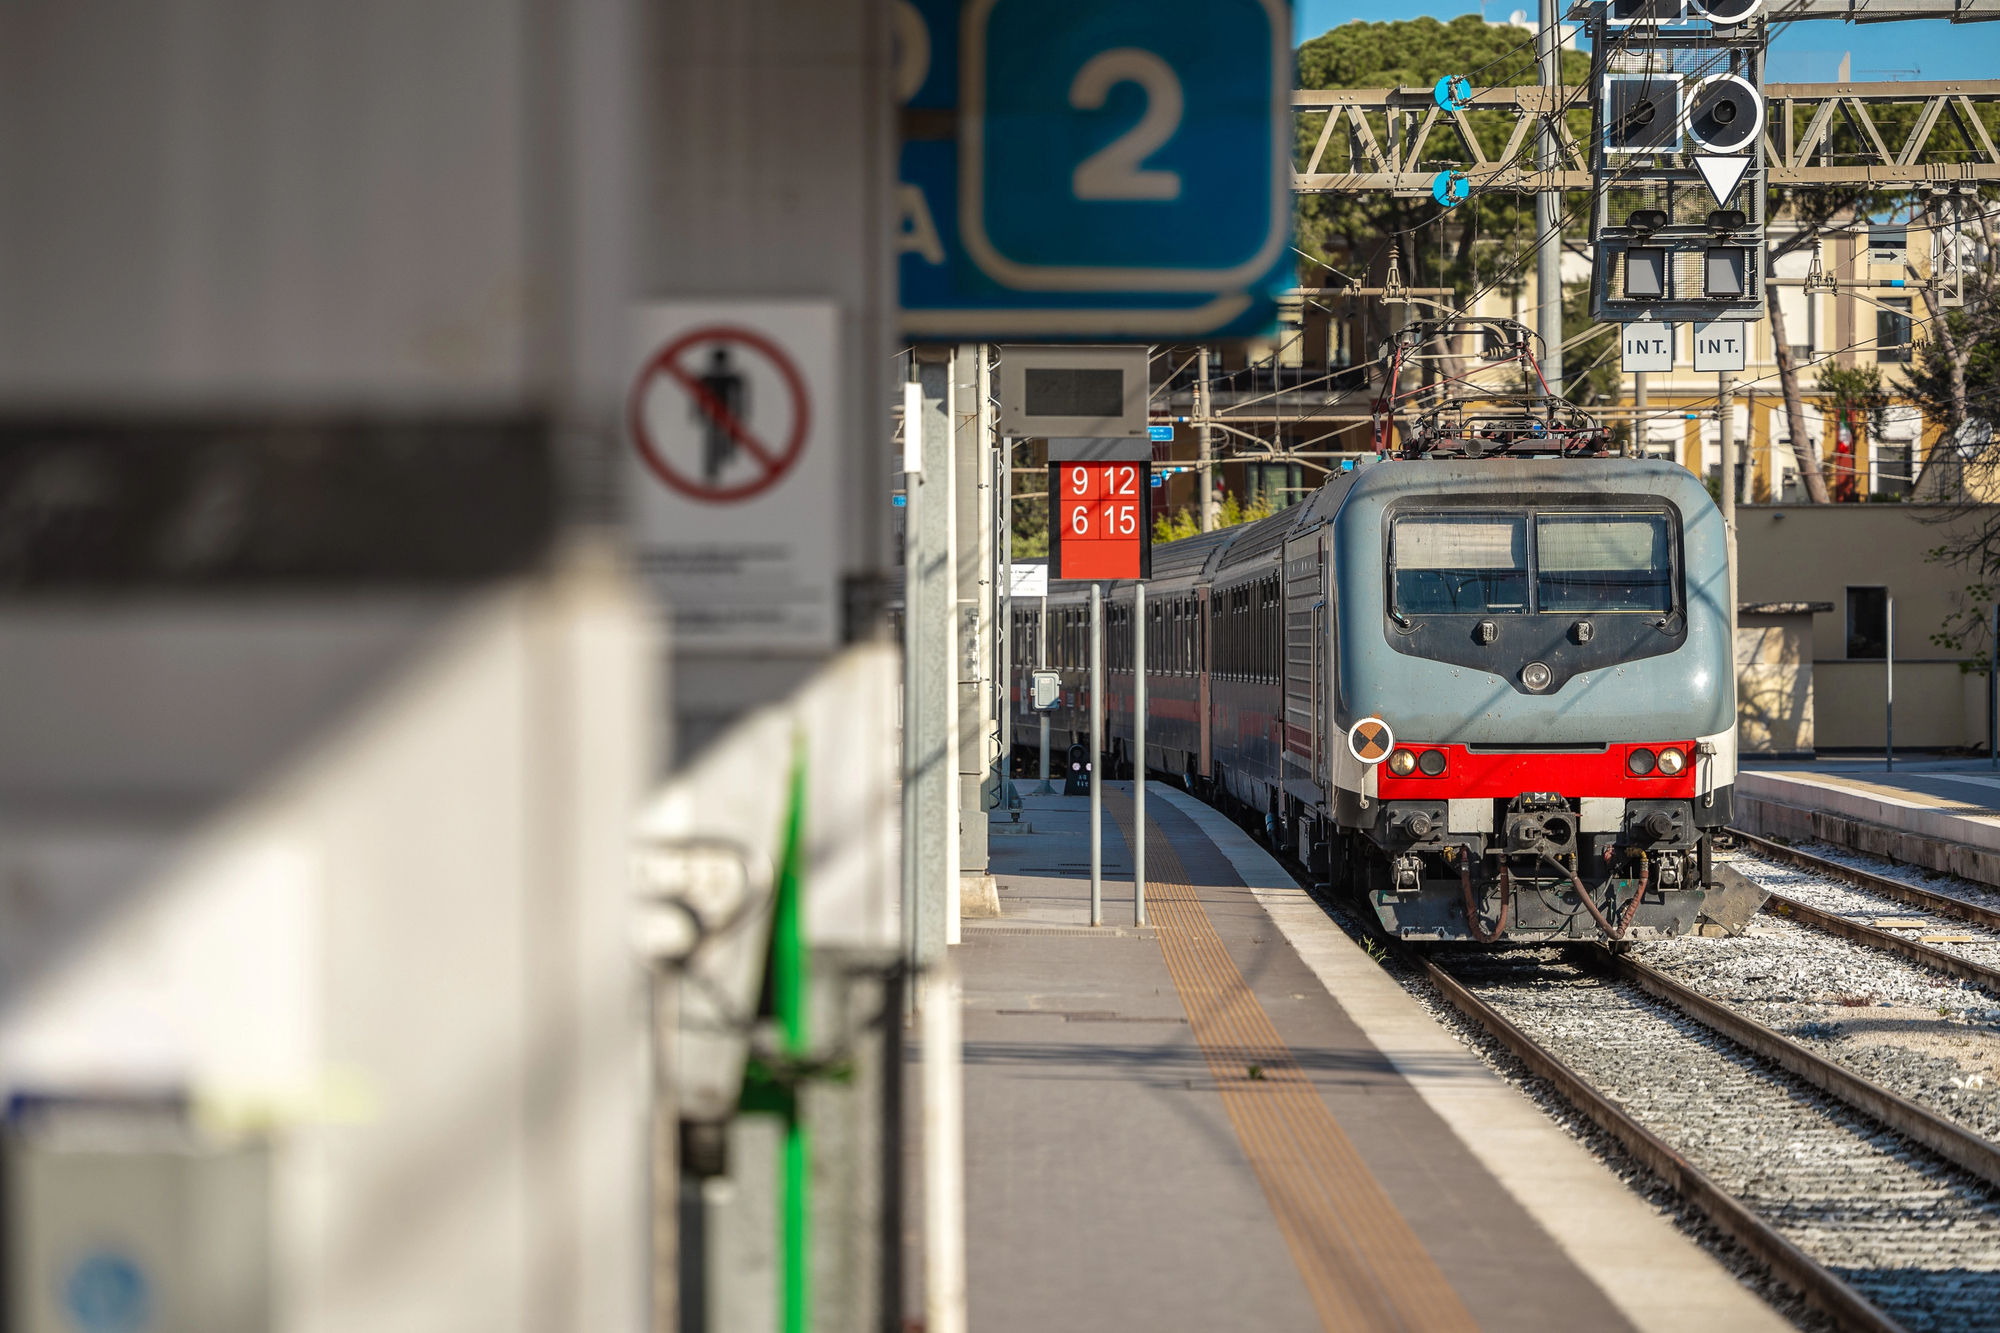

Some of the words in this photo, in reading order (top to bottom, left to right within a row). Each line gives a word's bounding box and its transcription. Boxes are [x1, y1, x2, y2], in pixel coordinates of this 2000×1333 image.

[1068, 46, 1185, 201] 2
[1627, 339, 1667, 355] INT.
[1699, 338, 1739, 354] INT.
[1072, 465, 1089, 495] 9
[1104, 465, 1136, 495] 12
[1072, 505, 1089, 535] 6
[1104, 505, 1136, 535] 15
